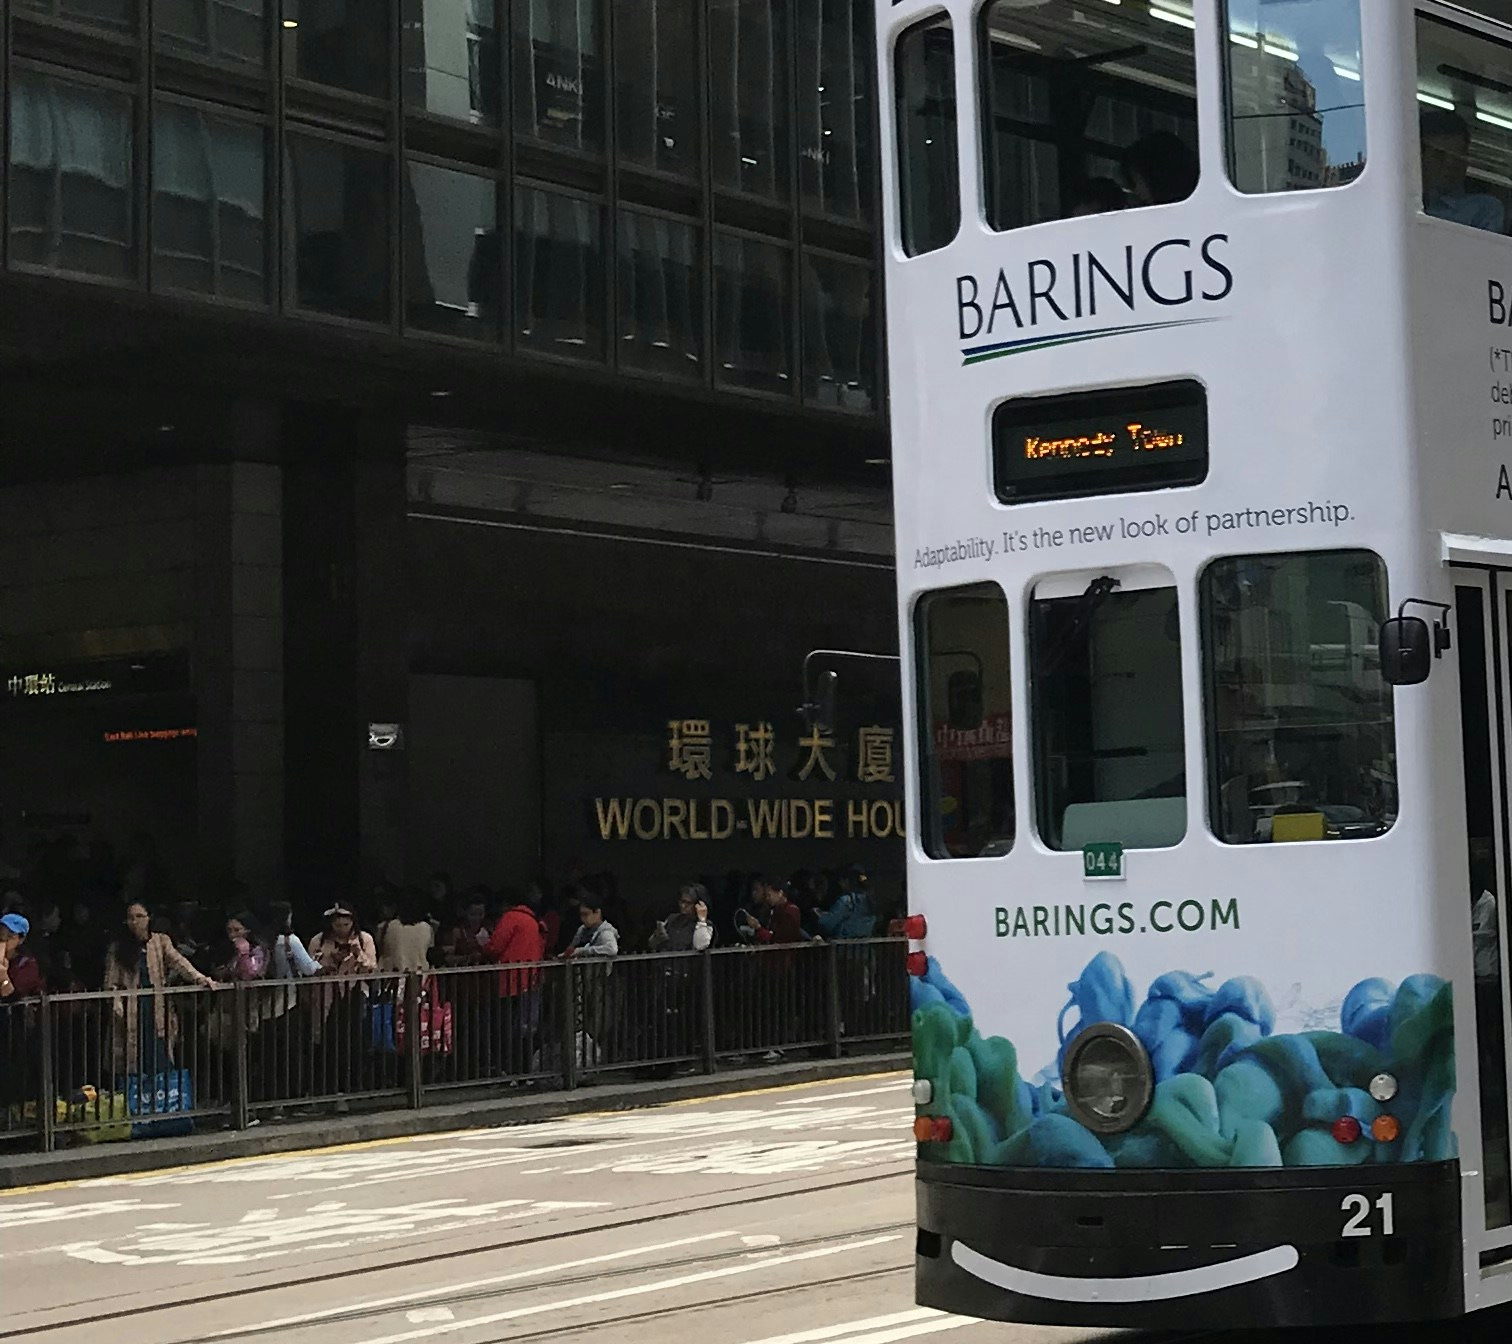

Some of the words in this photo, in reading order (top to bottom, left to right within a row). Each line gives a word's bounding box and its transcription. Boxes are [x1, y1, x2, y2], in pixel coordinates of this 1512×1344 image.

[956, 233, 1233, 340] BARINGS
[1496, 463, 1512, 499] A
[914, 537, 998, 569] Adaptability.
[1003, 530, 1028, 553] It's
[1033, 527, 1063, 549] the
[1069, 524, 1115, 544] new
[1120, 515, 1169, 538] look
[1176, 511, 1199, 533] of
[1206, 500, 1356, 536] partnership.
[666, 719, 895, 782] 環球大廈
[596, 797, 834, 840] WORLD-WIDE
[1086, 851, 1118, 871] 044
[995, 898, 1240, 937] BARINGS.COM
[1341, 1192, 1393, 1237] 21
